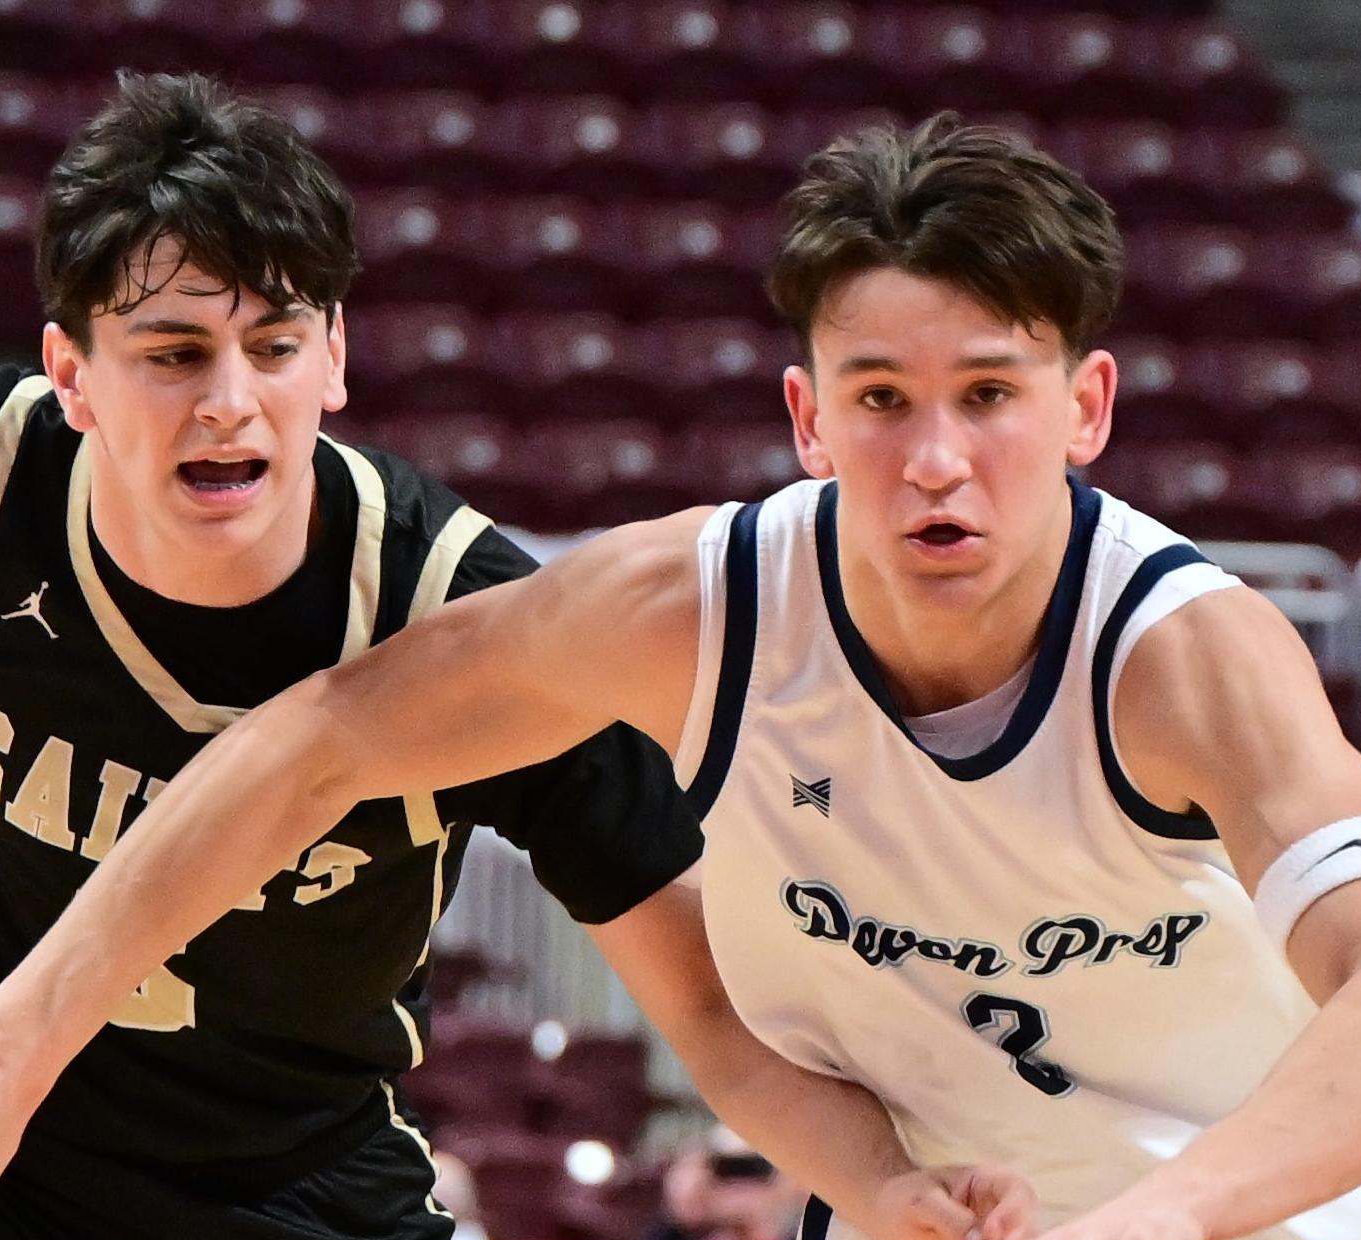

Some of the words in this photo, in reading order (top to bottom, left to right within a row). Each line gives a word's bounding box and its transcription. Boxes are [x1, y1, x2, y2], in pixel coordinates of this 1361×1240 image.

[780, 878, 1013, 980] Devon
[1019, 911, 1211, 978] Prep
[960, 990, 1078, 1098] 2
